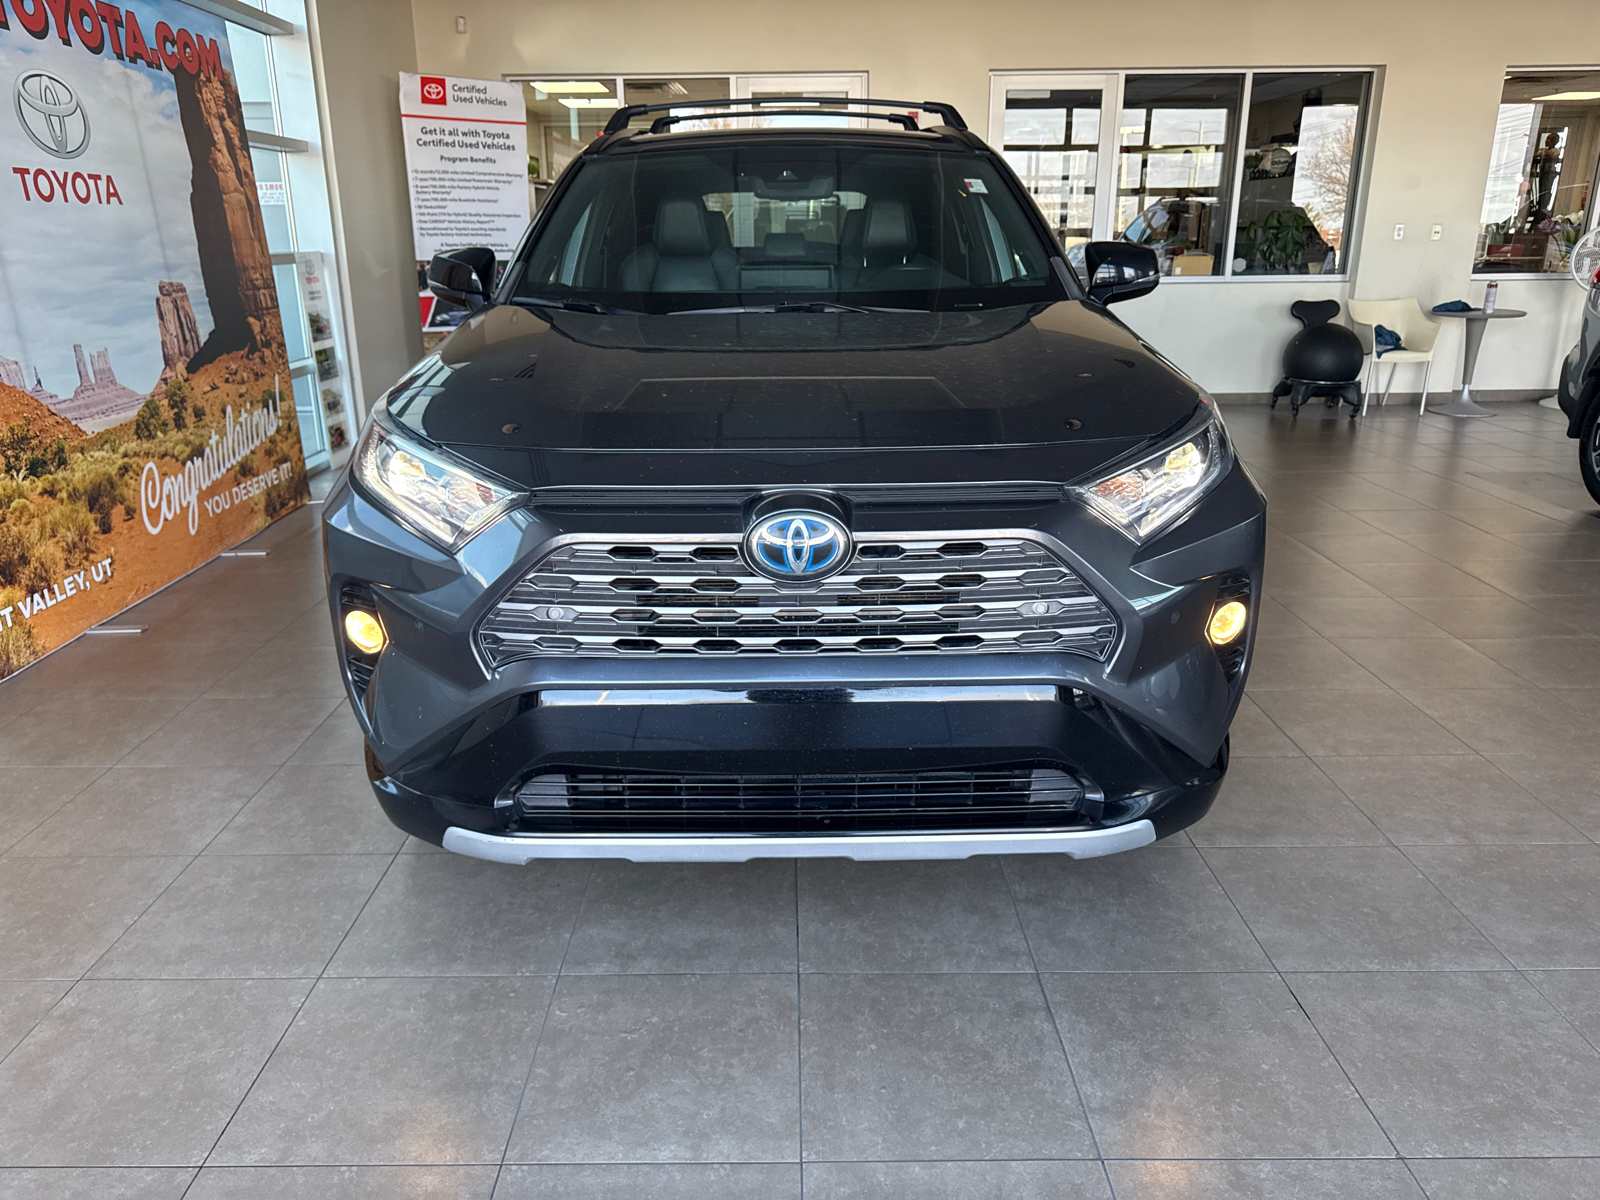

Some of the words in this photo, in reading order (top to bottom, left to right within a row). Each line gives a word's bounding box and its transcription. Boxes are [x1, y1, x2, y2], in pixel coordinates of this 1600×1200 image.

[452, 84, 487, 94] Certified
[453, 95, 474, 104] Used
[475, 97, 507, 107] Vehicles
[420, 126, 438, 136] Get
[439, 127, 446, 136] it
[448, 128, 459, 137] all
[461, 129, 480, 138] with
[482, 130, 510, 140] Toyota
[416, 138, 456, 148] Certified
[457, 140, 480, 149] Used
[481, 141, 516, 151] Vehicles
[440, 155, 469, 164] Program
[470, 156, 497, 164] Benefits
[12, 167, 123, 206] TOYOTA
[141, 373, 283, 536] Congratulations!
[204, 491, 231, 518] YOU
[232, 467, 279, 505] DESERVE
[280, 461, 293, 482] IT!
[17, 570, 91, 619] VALLEY,
[91, 557, 112, 582] UT
